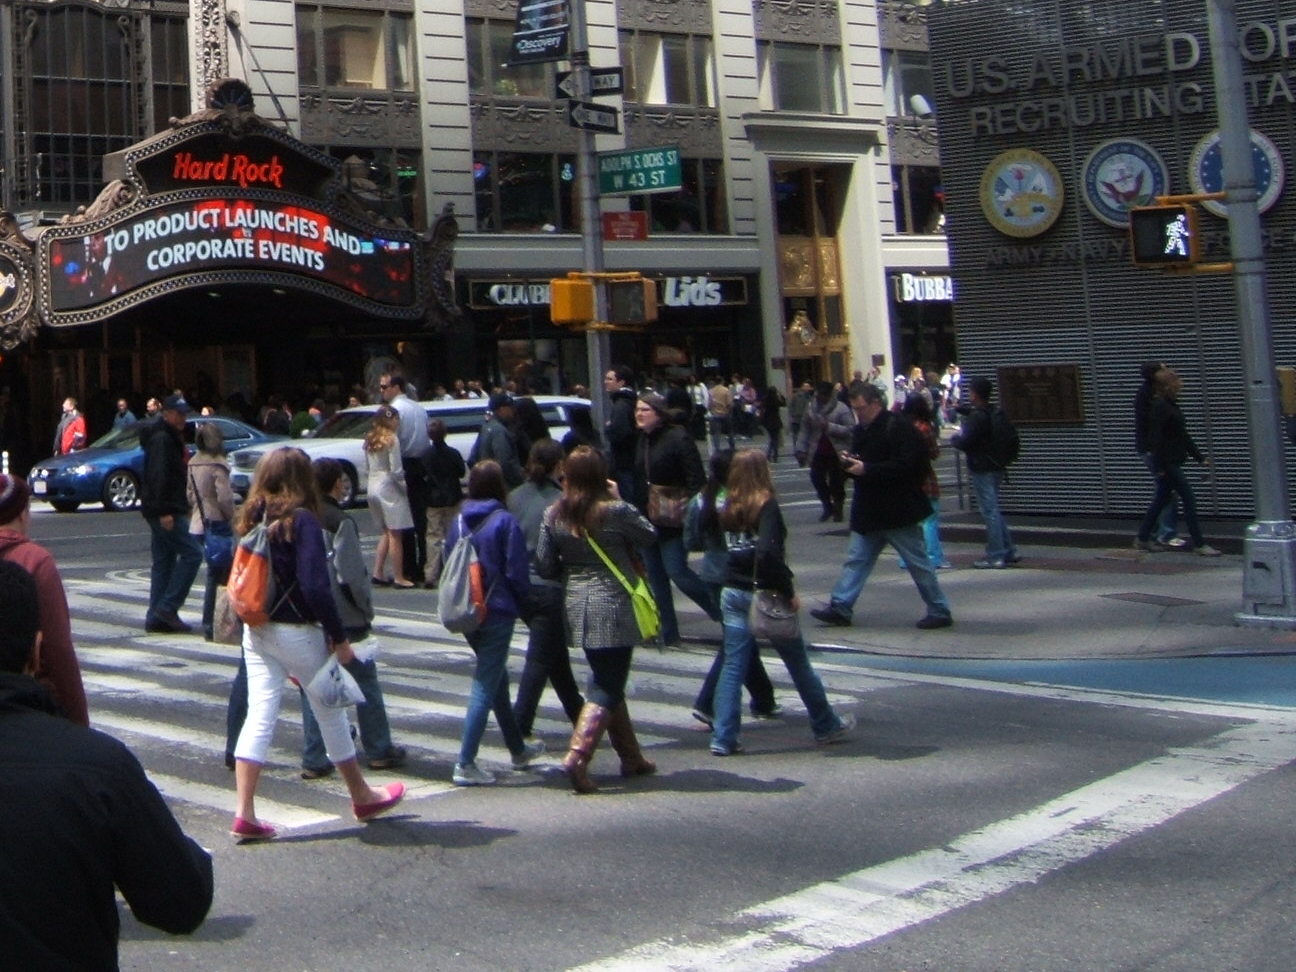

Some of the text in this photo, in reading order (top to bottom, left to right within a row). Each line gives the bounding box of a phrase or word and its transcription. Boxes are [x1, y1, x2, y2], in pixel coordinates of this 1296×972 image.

[516, 36, 562, 52] Discovery
[946, 56, 1017, 98] U.S.
[1028, 32, 1201, 89] ARMED
[969, 81, 1203, 136] RECRUITING
[173, 152, 284, 189] Hard Rock
[629, 172, 646, 187] 43
[650, 170, 666, 186] ST
[103, 207, 362, 256] TO PRODUCT LAUNCHES AND
[146, 237, 325, 271] CORPORATE EVENTS
[985, 245, 1043, 266] ARMY
[1061, 237, 1129, 263] NAVY
[489, 276, 722, 306] CLUB Lids
[902, 272, 954, 302] BUBBA
